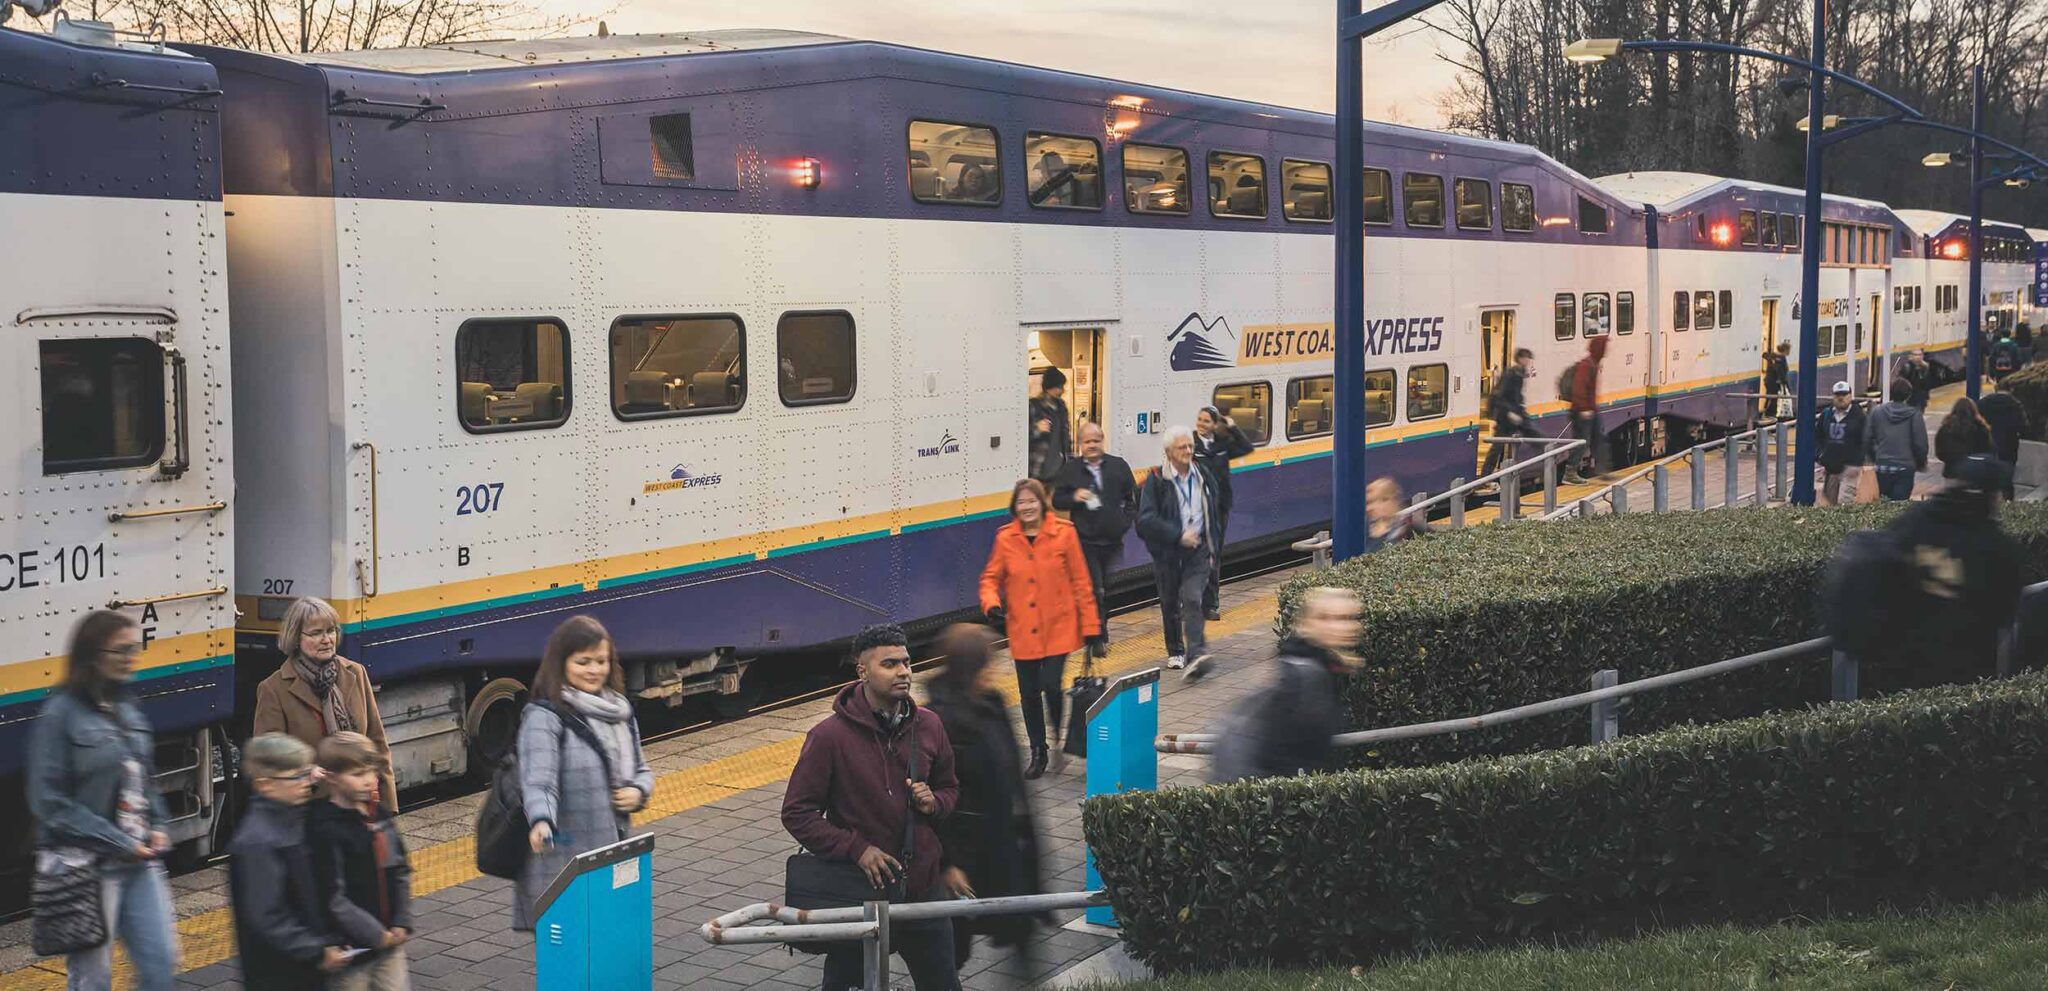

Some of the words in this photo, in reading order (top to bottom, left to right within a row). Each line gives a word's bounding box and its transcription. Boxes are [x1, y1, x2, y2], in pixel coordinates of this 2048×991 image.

[1834, 298, 1861, 317] EXPRS
[1245, 330, 1295, 358] WEST
[1296, 329, 1334, 355] COA
[1363, 317, 1444, 355] XPRESS
[917, 447, 939, 458] TRANS
[944, 444, 960, 454] LINK
[645, 483, 664, 492] WEST
[663, 481, 683, 490] COAST
[682, 474, 722, 489] EXPRESS
[456, 482, 504, 515] 207
[0, 553, 39, 591] CE
[54, 542, 104, 583] 101
[458, 546, 470, 567] B
[263, 578, 294, 595] 207
[141, 602, 159, 624] A
[142, 626, 156, 651] F
